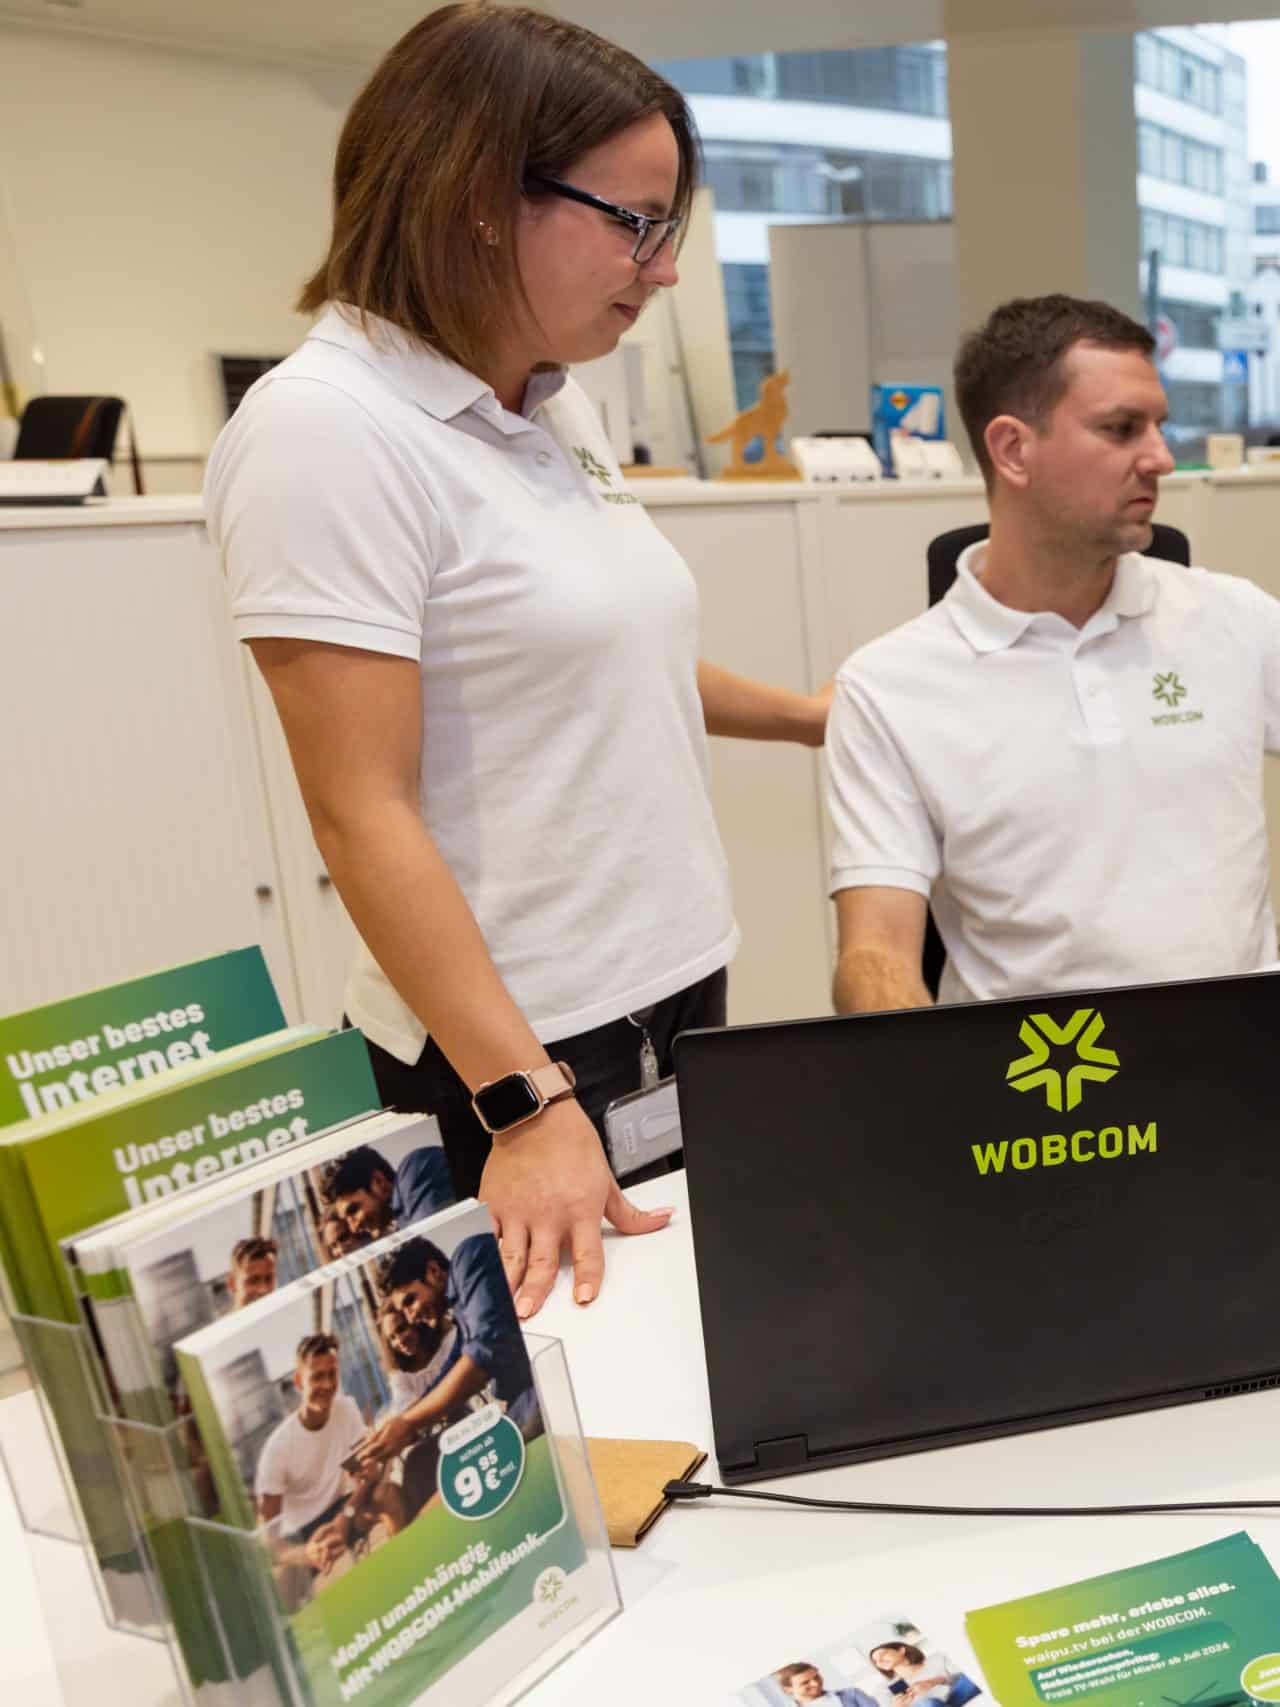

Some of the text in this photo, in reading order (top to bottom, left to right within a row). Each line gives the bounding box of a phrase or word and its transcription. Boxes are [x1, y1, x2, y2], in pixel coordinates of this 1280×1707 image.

[6, 1003, 205, 1079] Unser bestes
[19, 1031, 211, 1119] Internet
[113, 1088, 305, 1173] Unser bestes
[123, 1116, 309, 1210] Internet
[971, 1121, 1158, 1175] WOBCOM
[331, 1541, 491, 1668] Mobil unabhängig.
[1015, 1583, 1236, 1648] Spare mehr, erlebe alles.
[1023, 1606, 1212, 1664] waipu.tv bei der WOBCOM.
